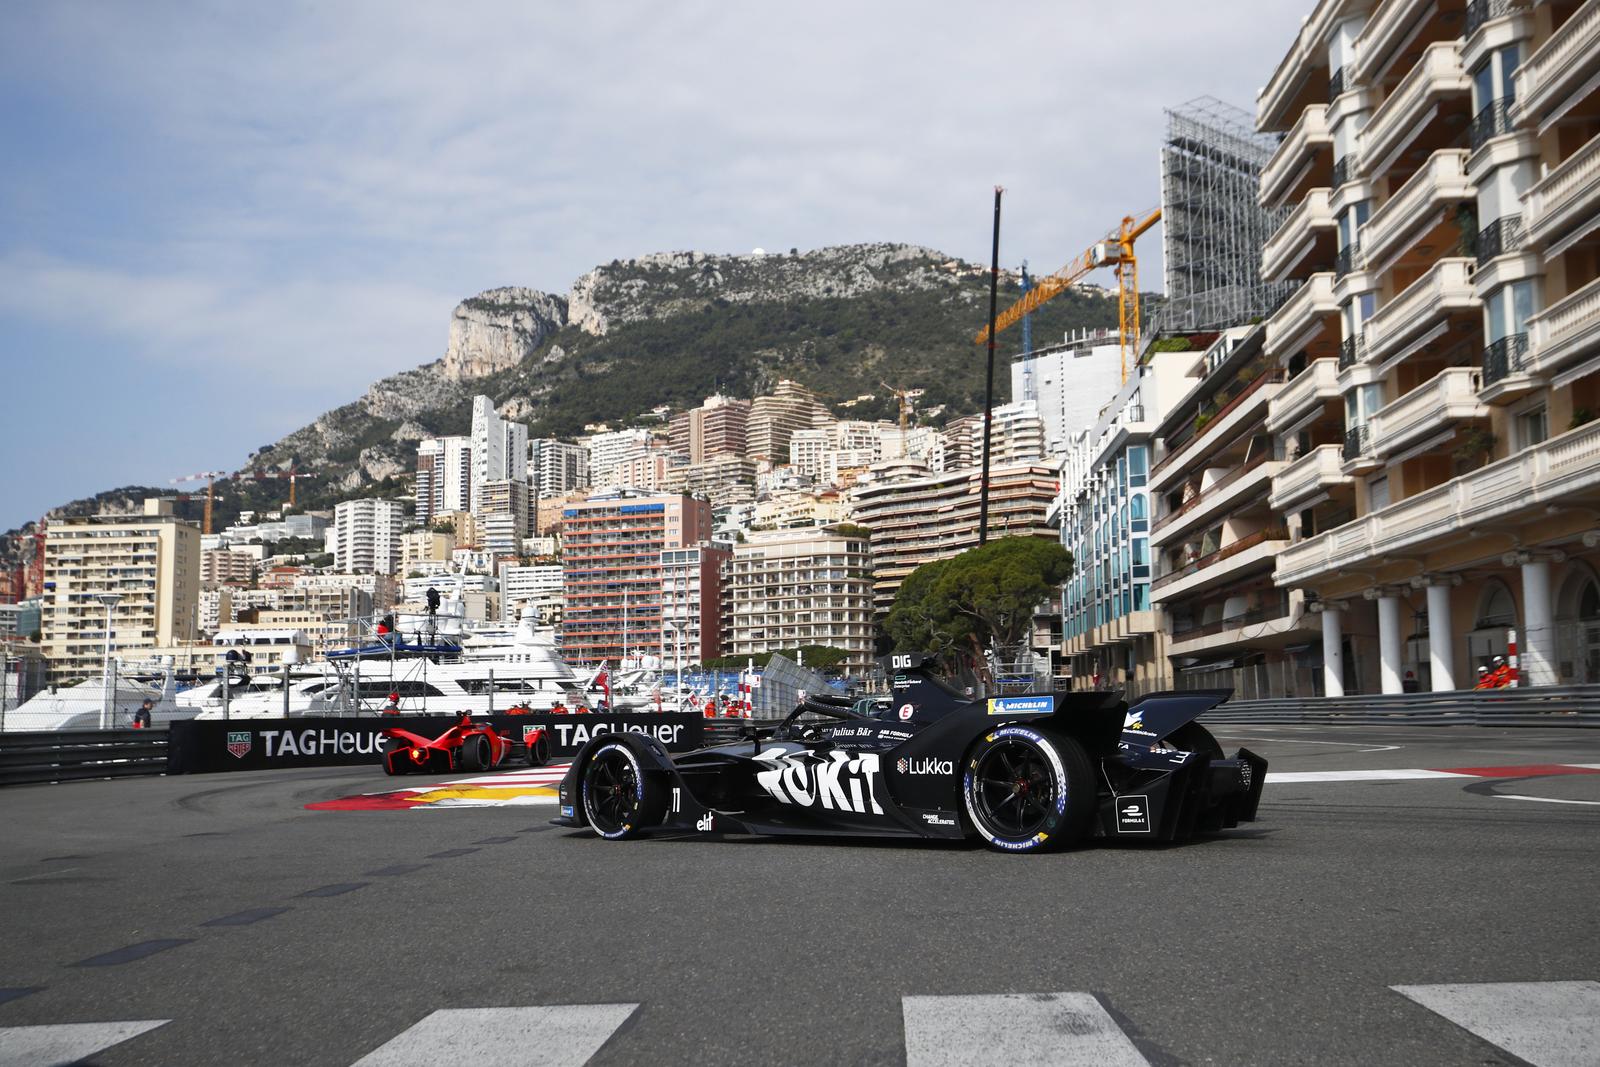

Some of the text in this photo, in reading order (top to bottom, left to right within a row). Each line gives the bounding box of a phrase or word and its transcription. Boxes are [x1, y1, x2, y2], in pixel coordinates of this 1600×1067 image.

[892, 655, 911, 668] DIG
[1006, 701, 1048, 709] MICHELIN
[230, 734, 249, 742] TAG
[832, 727, 855, 738] Julius
[857, 727, 873, 736] Bär
[1000, 728, 1039, 741] MICHELIN
[910, 757, 953, 775] Lukka
[994, 839, 1033, 849] MICHELIN
